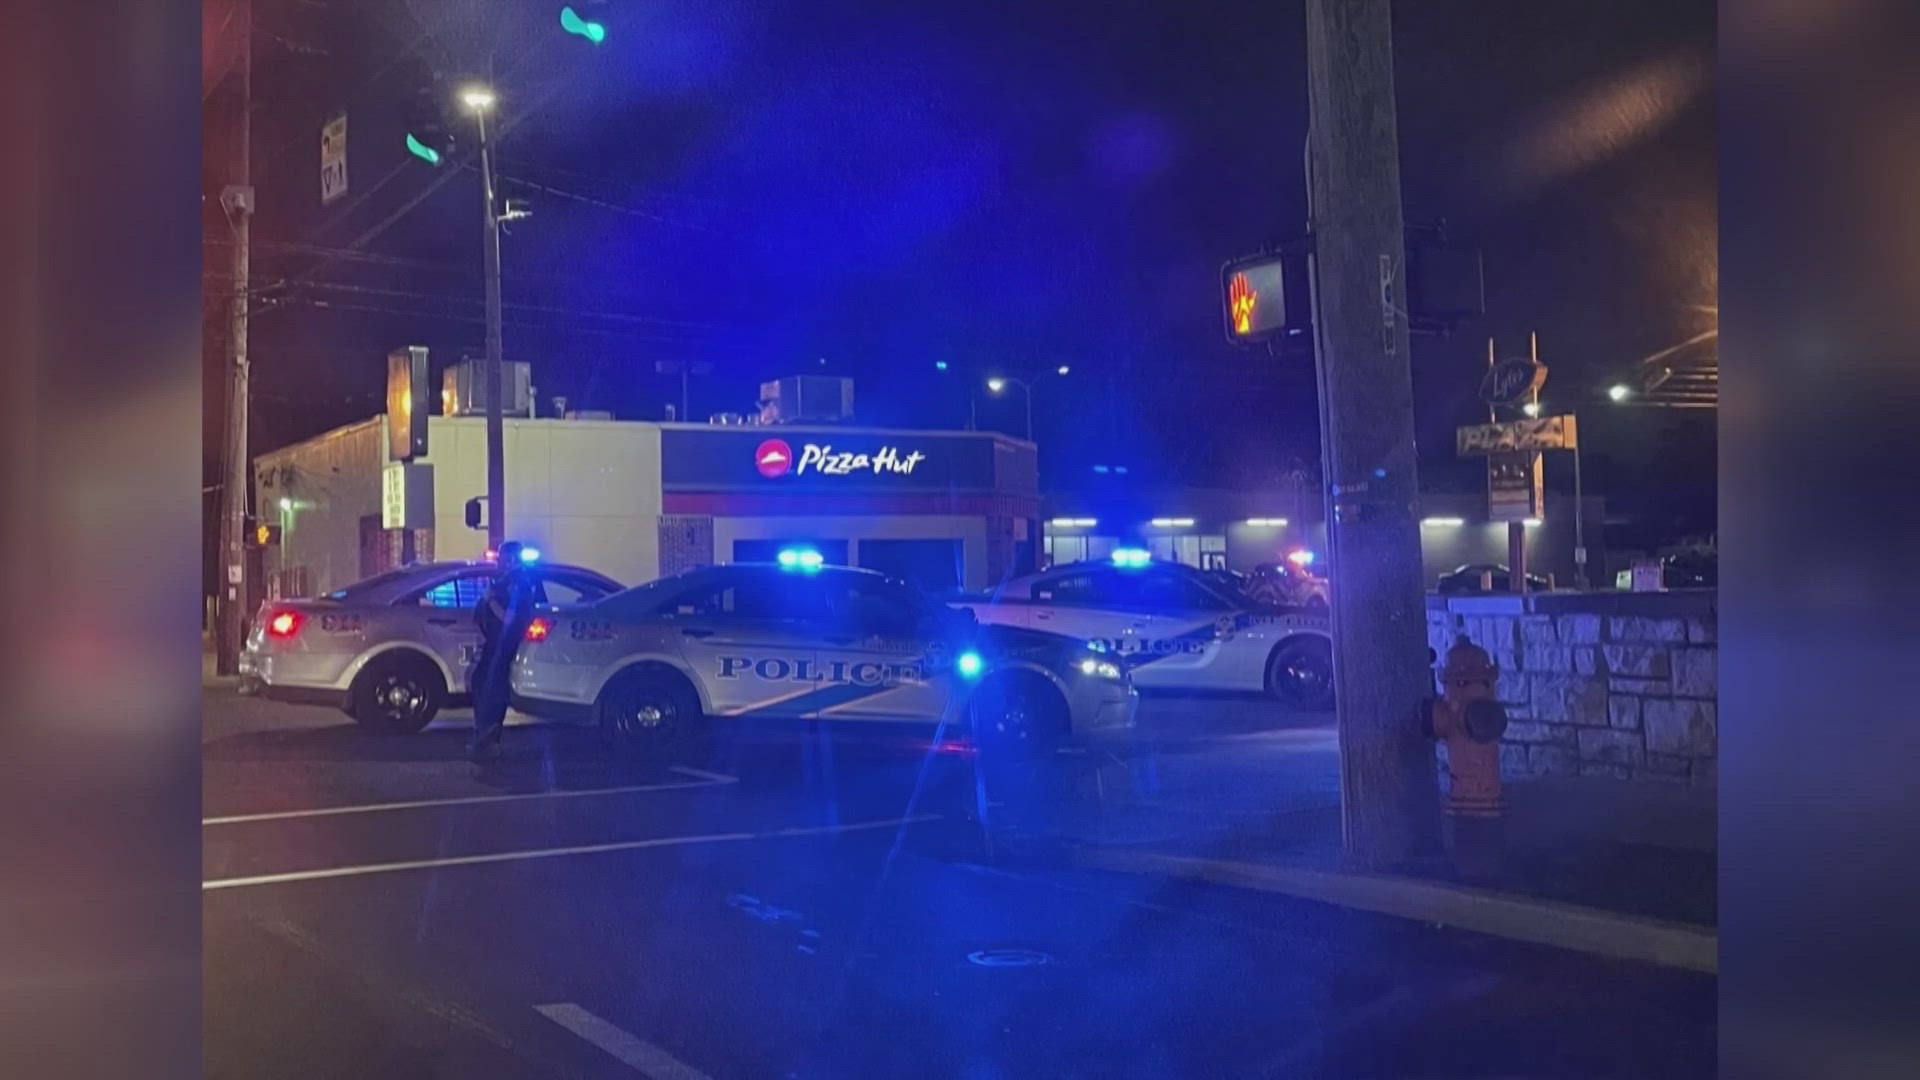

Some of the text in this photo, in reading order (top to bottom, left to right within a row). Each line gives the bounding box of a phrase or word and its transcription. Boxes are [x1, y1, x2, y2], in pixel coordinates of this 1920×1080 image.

[797, 443, 926, 476] Pizza Hut
[715, 656, 927, 686] POLICE
